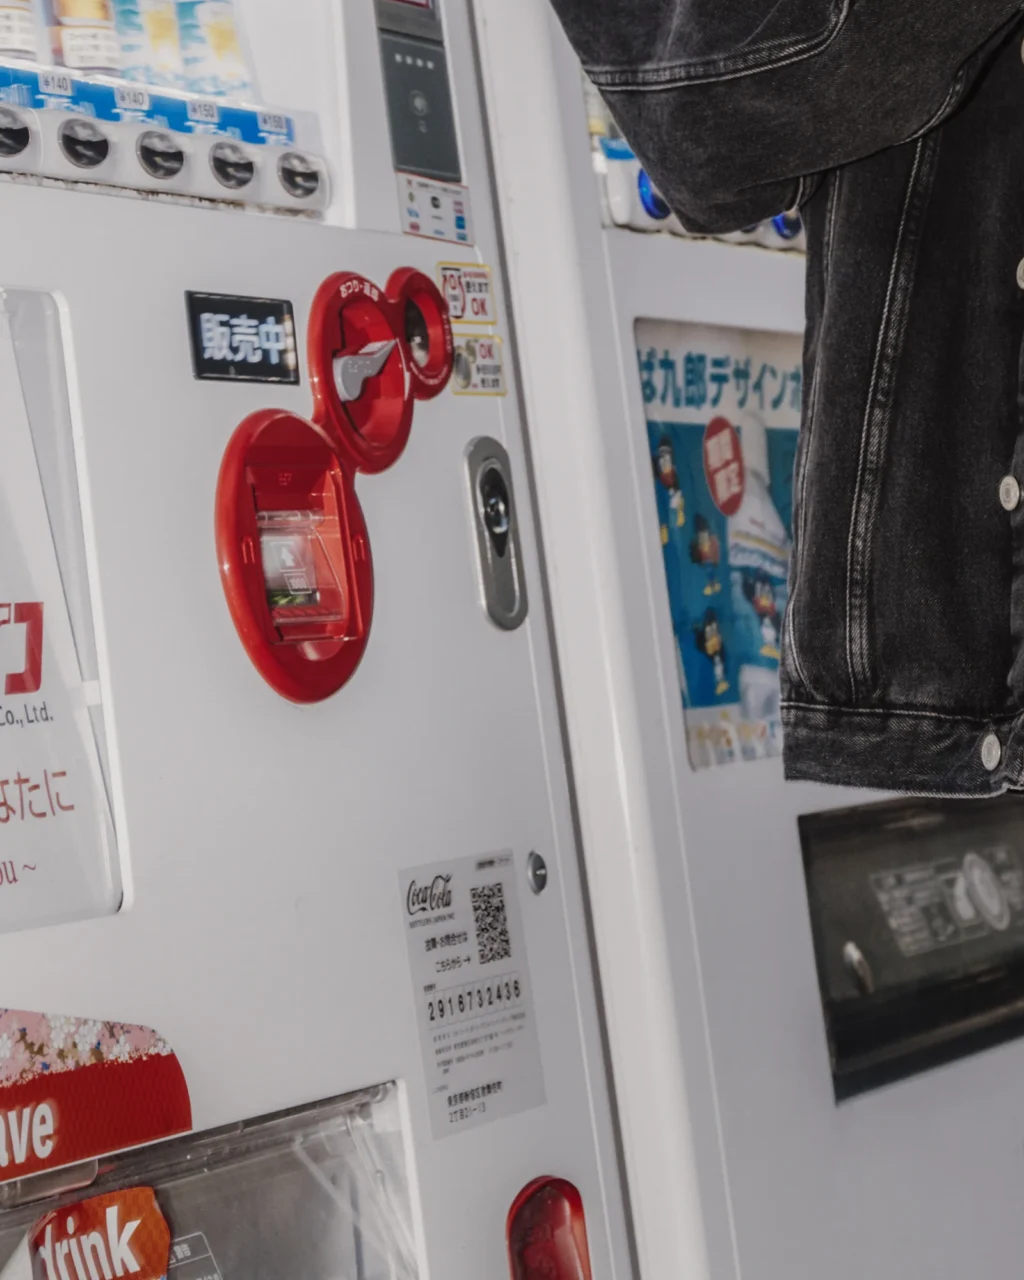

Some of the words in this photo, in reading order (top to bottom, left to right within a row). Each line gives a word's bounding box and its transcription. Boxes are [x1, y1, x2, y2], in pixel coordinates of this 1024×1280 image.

[199, 312, 286, 365] 販売中
[23, 701, 54, 724] Ltd.
